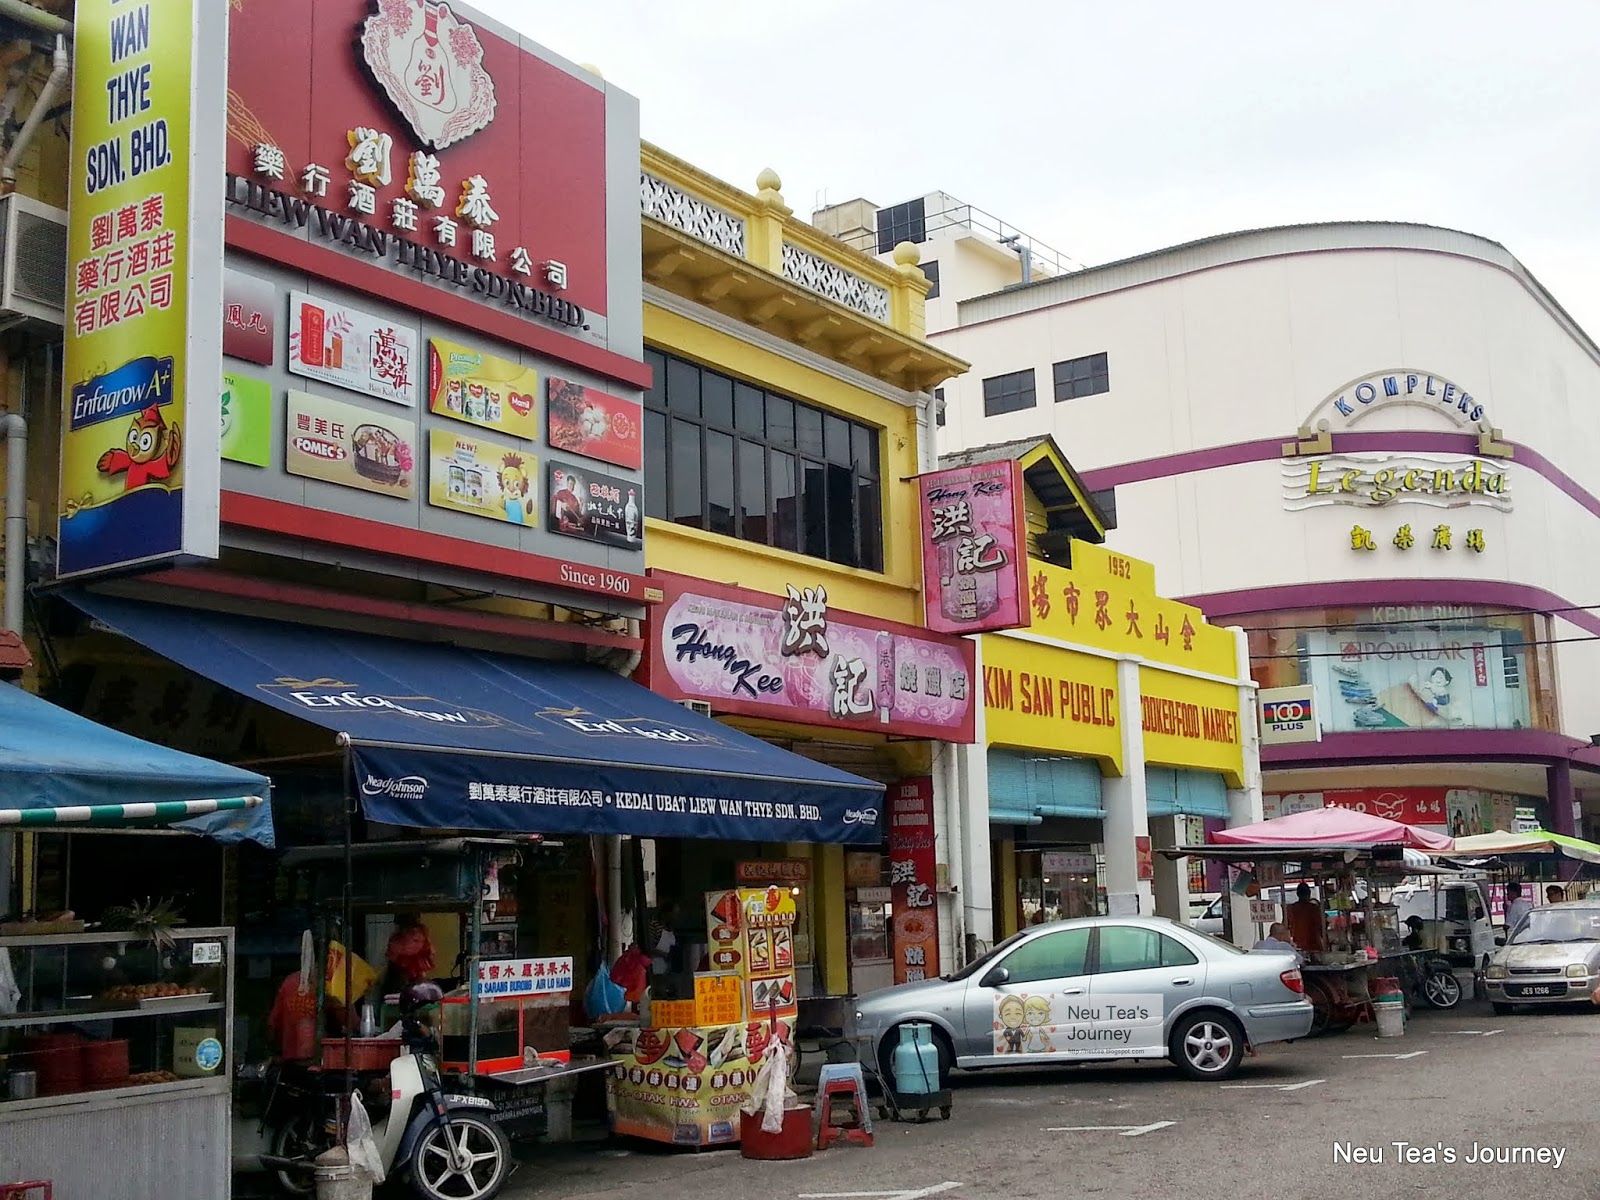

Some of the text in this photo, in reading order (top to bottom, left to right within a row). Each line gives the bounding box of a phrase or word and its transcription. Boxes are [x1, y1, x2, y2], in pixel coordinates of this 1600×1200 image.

[111, 4, 149, 63] WAN
[107, 64, 151, 125] THYE
[86, 119, 171, 194] SDN. BHD.
[346, 126, 499, 229] 劉萬泰
[91, 194, 164, 251] 劉萬泰
[225, 172, 308, 229] LIEW
[316, 211, 388, 258] WAN
[390, 238, 470, 286] THYE
[76, 232, 175, 297] 藥行酒莊
[75, 273, 173, 337] 有限公司
[74, 381, 148, 421] Enfagrow
[1334, 374, 1485, 422] KOMPLEKS
[296, 437, 345, 460] FOMEC'S
[927, 481, 1005, 504] Hong Kee
[1306, 459, 1506, 501] Legenda
[931, 500, 1008, 576] 洪記
[560, 564, 596, 586] Since
[599, 573, 631, 594] 1960
[1108, 555, 1132, 580] 1952
[671, 623, 784, 698] Hong Kee
[781, 583, 876, 720] 洪記
[1365, 640, 1467, 661] POPULAR
[982, 665, 1116, 728] KIM SAN PUBLIC
[1271, 702, 1304, 723] 100
[1201, 706, 1238, 744] MARKET
[1272, 722, 1304, 732] PLUS
[468, 782, 604, 808] 劉萬泰藥行酒莊有限公司
[615, 792, 822, 821] KEDAI UBAT LIEW WAN THYE SDN. BHD.
[891, 859, 933, 908] 洪記
[484, 981, 508, 993] SARANG
[535, 978, 546, 990] AIR
